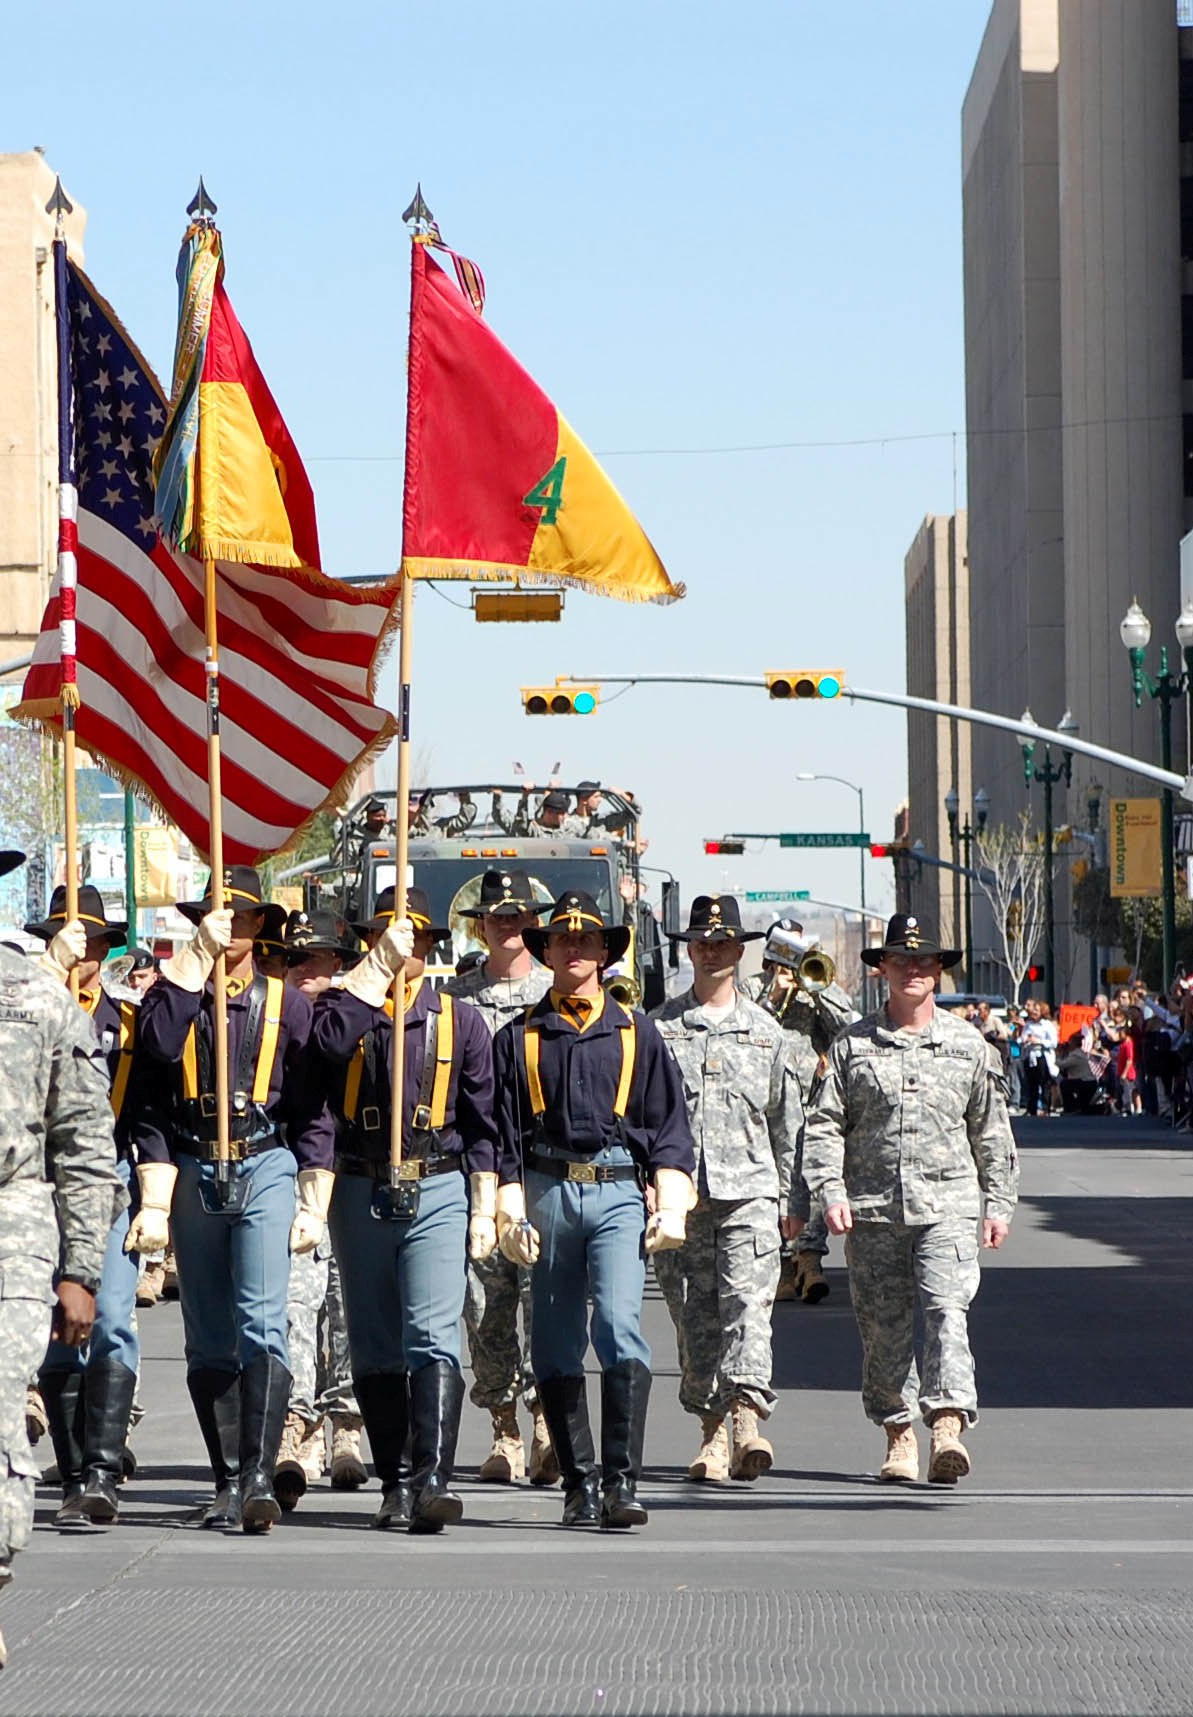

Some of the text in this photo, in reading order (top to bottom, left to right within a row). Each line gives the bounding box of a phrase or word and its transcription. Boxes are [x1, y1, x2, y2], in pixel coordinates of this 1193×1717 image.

[523, 456, 567, 525] 4
[140, 831, 149, 902] Downtown
[796, 835, 853, 846] KANSAS
[1115, 803, 1127, 885] Downtown
[6, 1009, 34, 1020] ARMY
